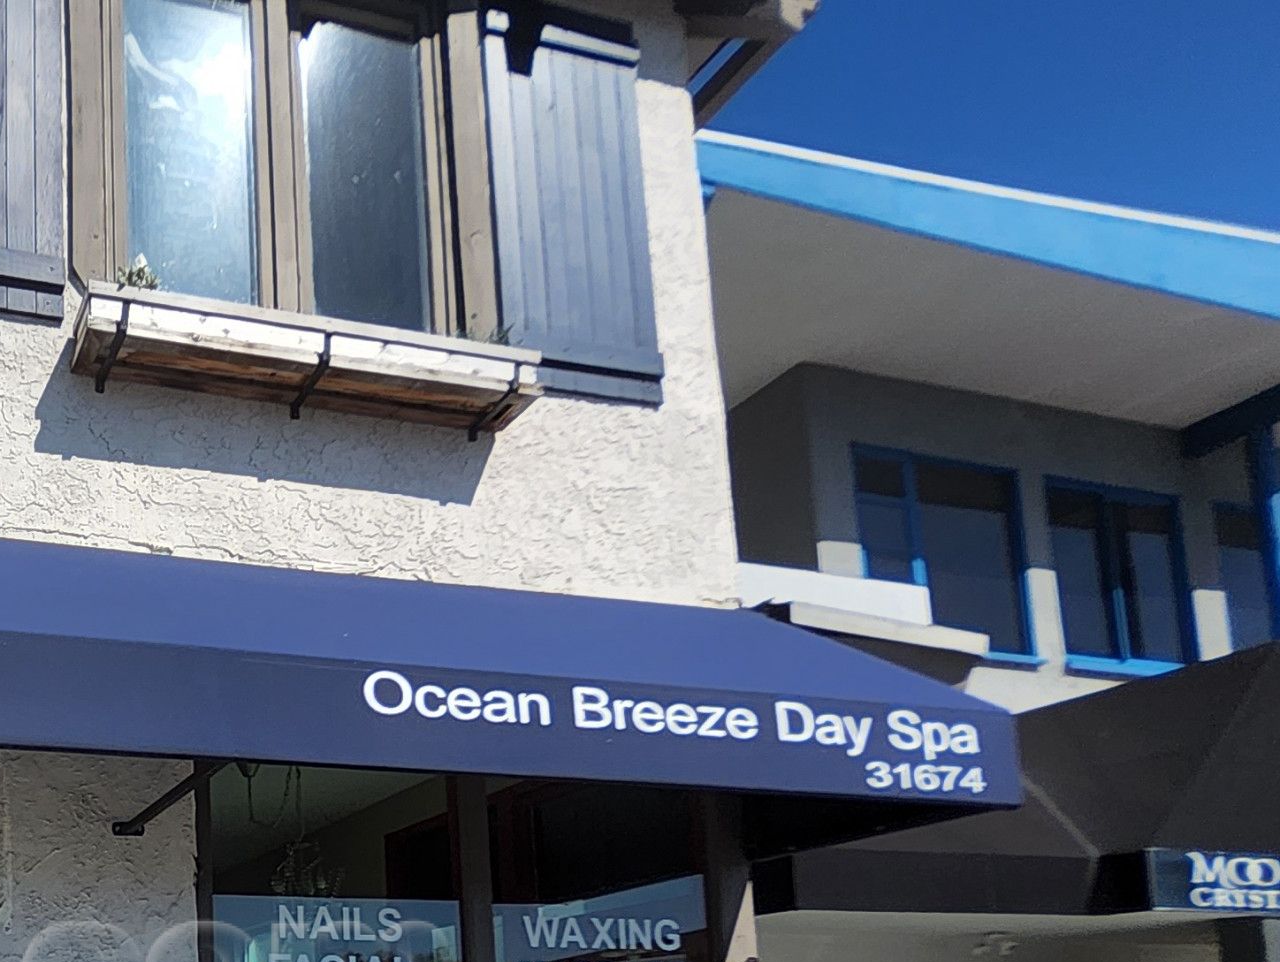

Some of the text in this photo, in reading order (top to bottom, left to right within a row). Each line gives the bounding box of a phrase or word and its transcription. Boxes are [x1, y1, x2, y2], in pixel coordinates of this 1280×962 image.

[363, 670, 981, 761] Ocean Breeze Day Spa
[865, 760, 988, 794] 31674
[277, 904, 403, 943] NAILS
[523, 914, 681, 951] WAXING
